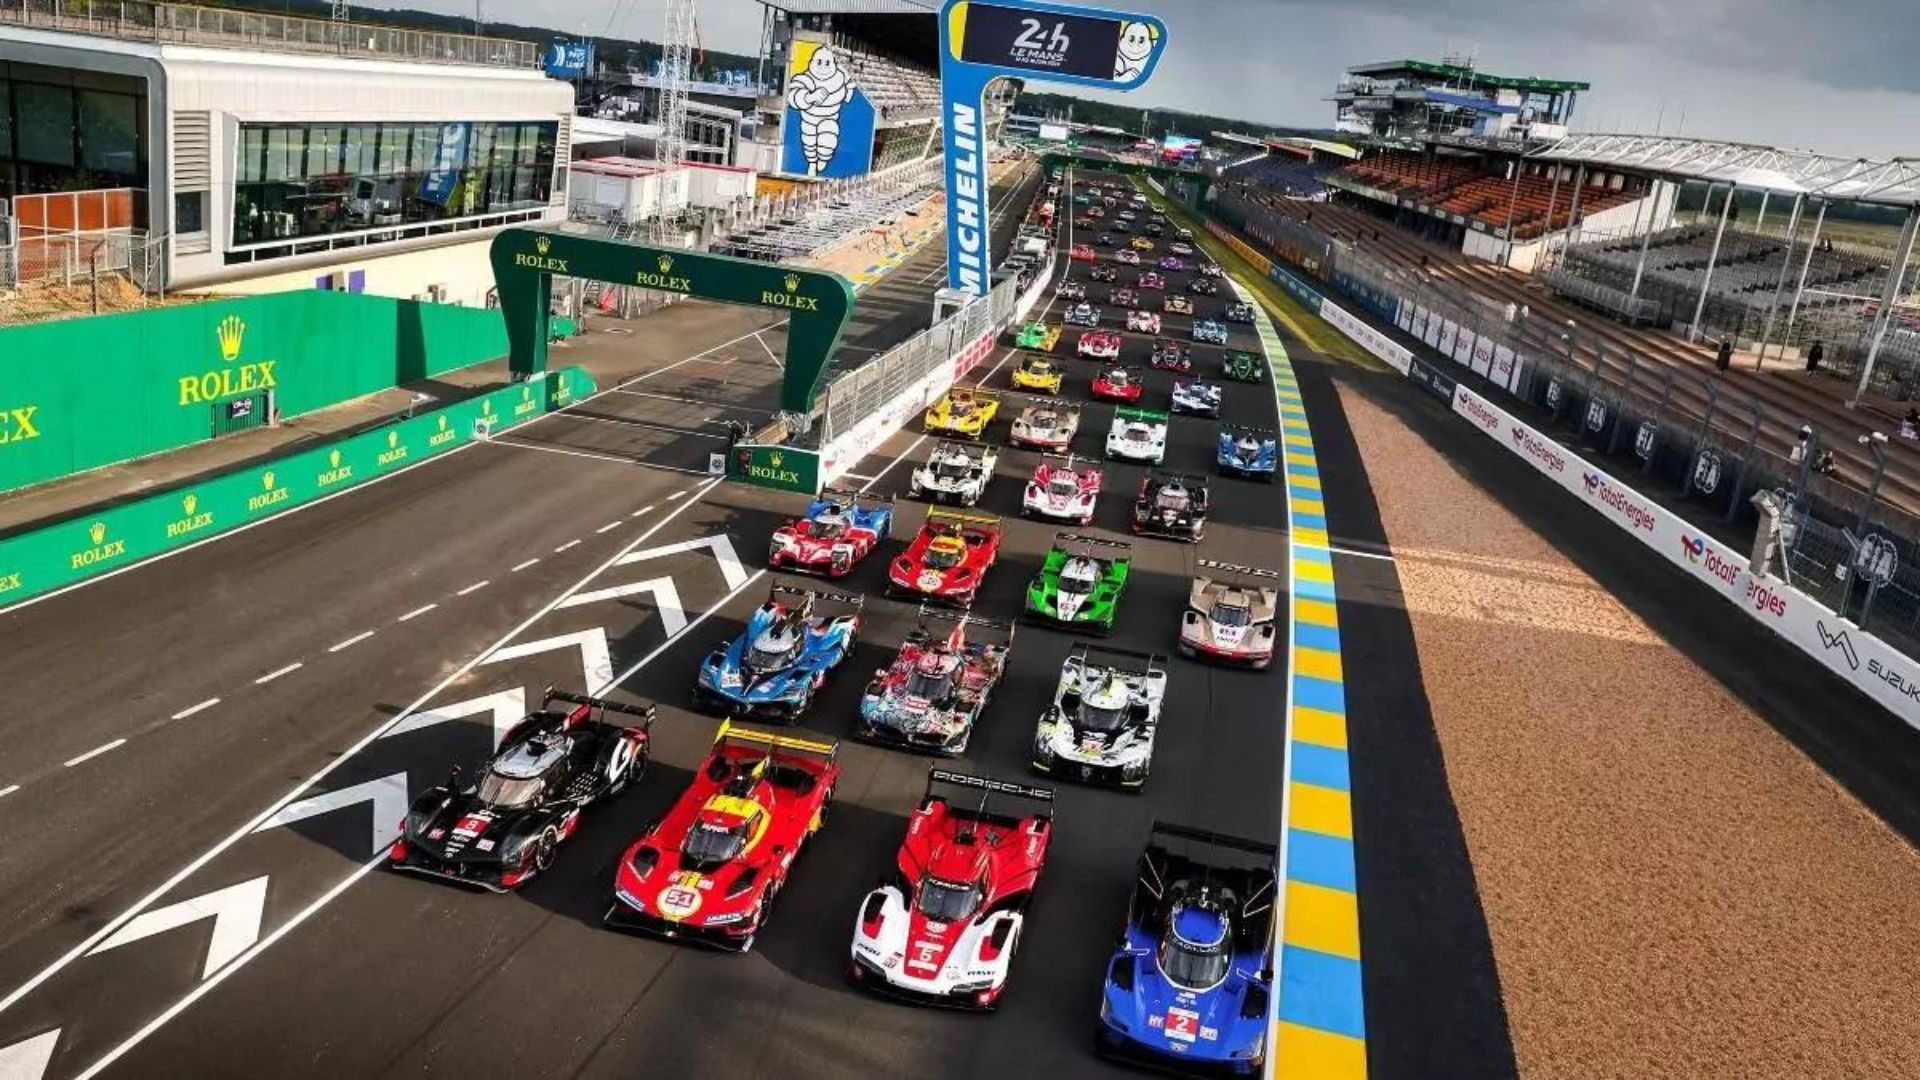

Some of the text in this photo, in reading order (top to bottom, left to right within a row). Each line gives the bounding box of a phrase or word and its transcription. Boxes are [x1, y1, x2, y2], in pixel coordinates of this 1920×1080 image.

[1010, 47, 1026, 57] LE
[1027, 49, 1065, 62] MANS
[515, 253, 569, 272] ROLEX
[636, 271, 691, 291] ROLEX
[761, 290, 819, 311] ROLEX
[178, 360, 276, 405] ROLEX
[429, 428, 456, 446] ROLEX
[378, 446, 408, 466] ROLEX
[318, 465, 353, 487] ROLEX
[750, 466, 799, 484] ROLEX
[248, 487, 289, 511] ROLEX
[1599, 481, 1656, 533] TotalEnergies
[166, 511, 214, 538] ROLEX
[71, 540, 125, 569] ROLEX
[933, 770, 1052, 799] PORSCHE
[665, 889, 695, 908] 51
[1175, 1016, 1190, 1031] 2
